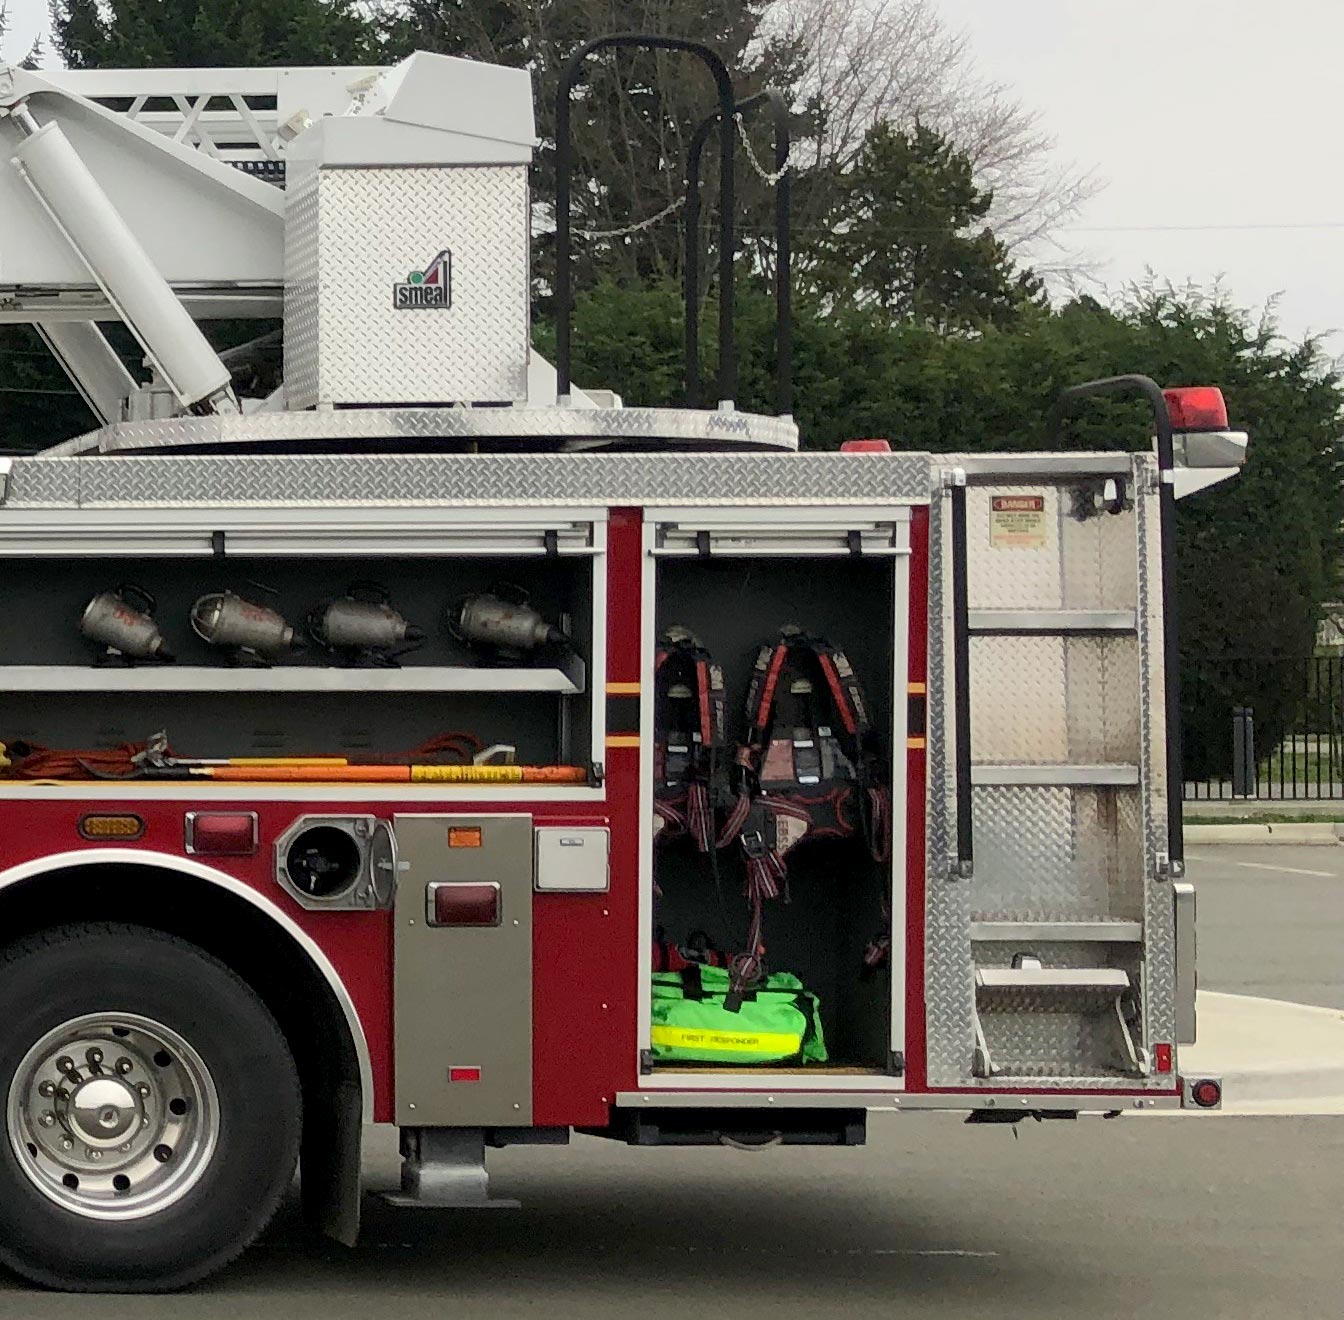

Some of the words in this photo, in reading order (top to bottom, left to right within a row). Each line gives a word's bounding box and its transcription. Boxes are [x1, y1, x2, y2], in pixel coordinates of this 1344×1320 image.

[398, 260, 448, 305] smeal
[681, 1034, 705, 1043] FIRST
[710, 1036, 760, 1046] RESPONDER
